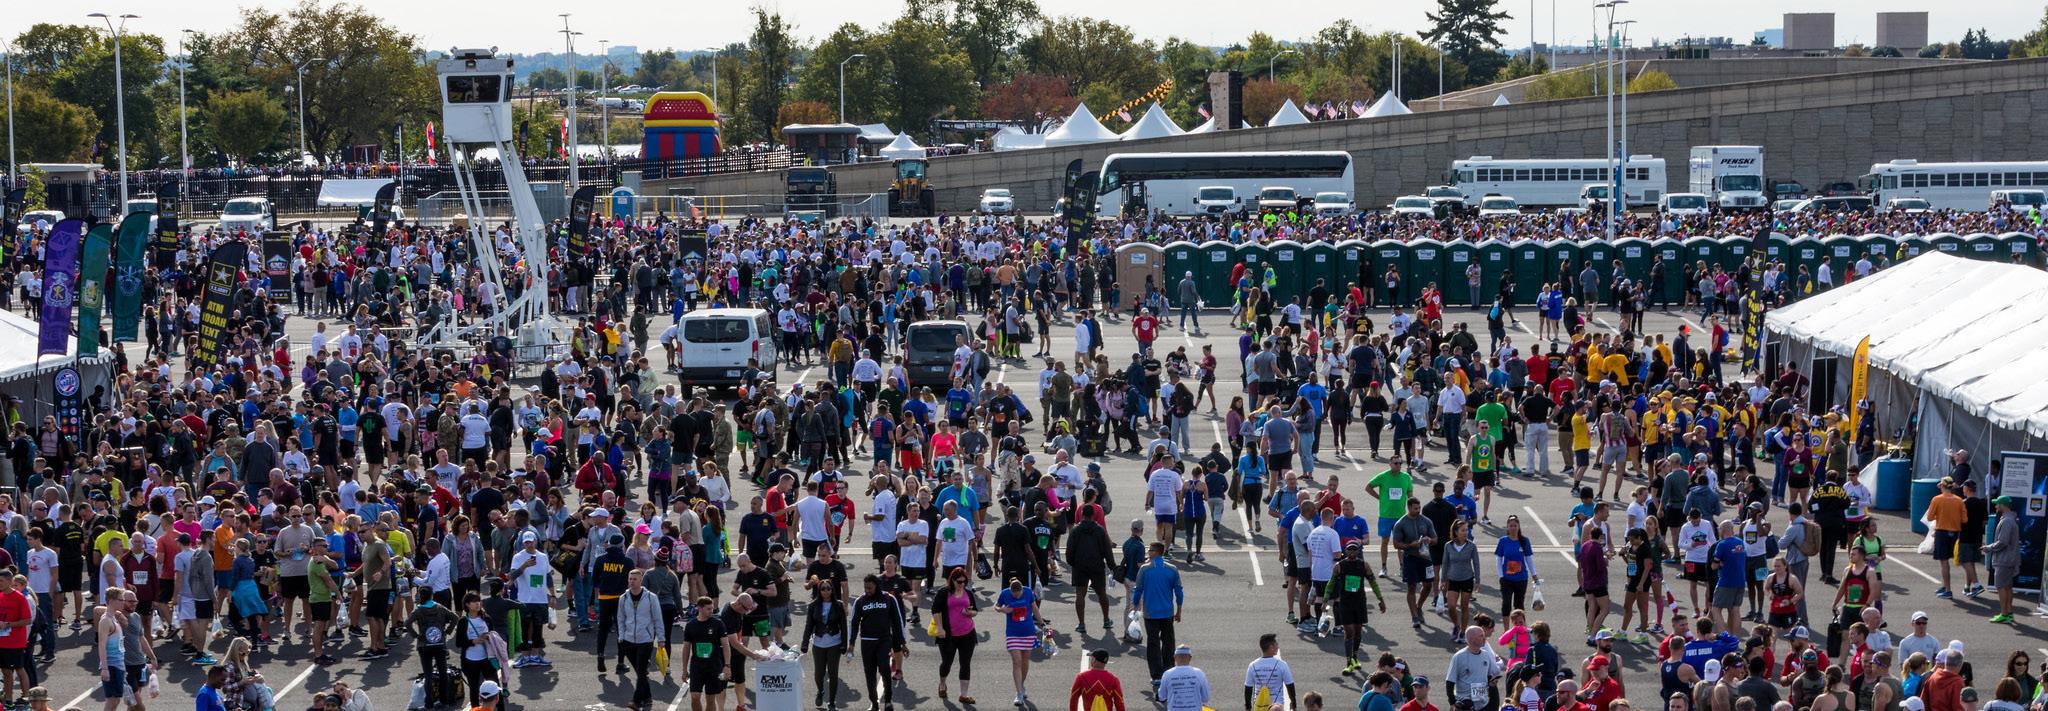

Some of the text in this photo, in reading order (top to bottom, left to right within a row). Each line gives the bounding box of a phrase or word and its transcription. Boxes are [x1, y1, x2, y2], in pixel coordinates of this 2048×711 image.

[207, 301, 224, 314] ATM
[201, 325, 220, 339] TENT
[1828, 484, 1848, 500] ARMY
[603, 562, 625, 573] NAVY
[862, 601, 887, 611] adidas
[760, 674, 787, 684] ARMY
